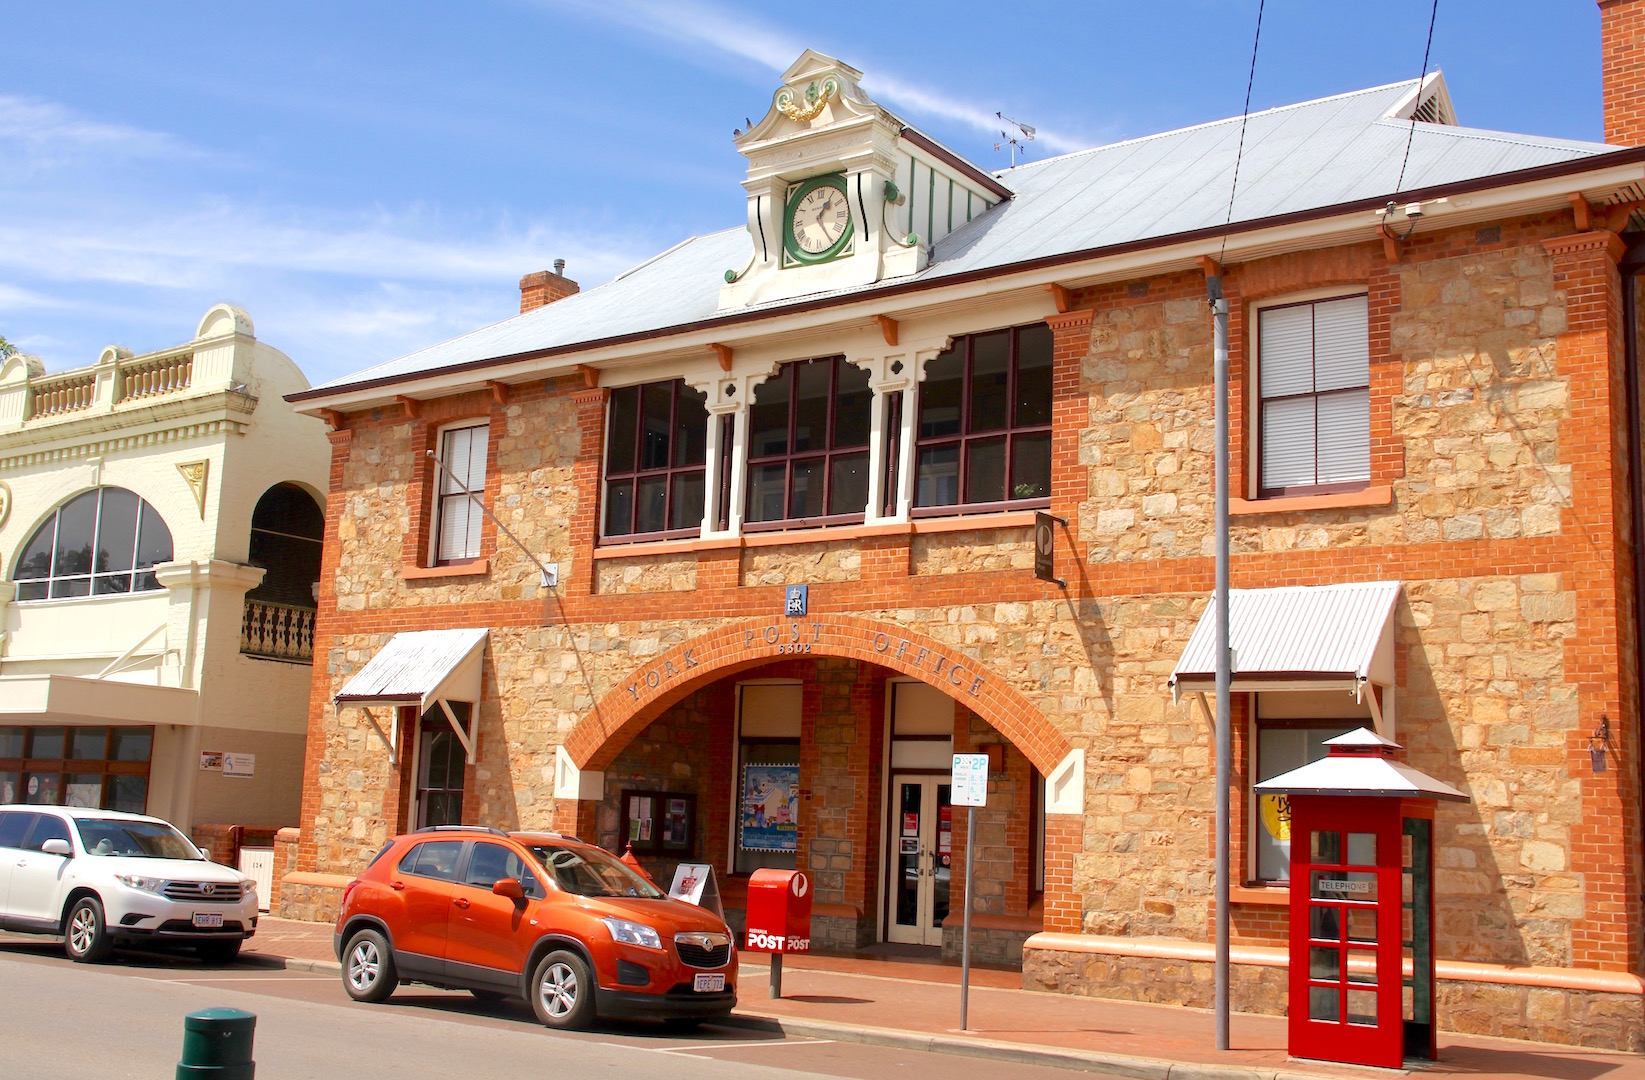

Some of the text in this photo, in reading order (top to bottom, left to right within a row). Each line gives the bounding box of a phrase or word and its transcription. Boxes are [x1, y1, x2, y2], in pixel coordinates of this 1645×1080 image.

[778, 642, 811, 655] 6302
[627, 622, 985, 701] YORK POST OFFICE
[972, 758, 986, 770] 2P
[1321, 881, 1367, 891] TELEPHONE
[748, 934, 785, 950] POST
[787, 939, 810, 951] POST
